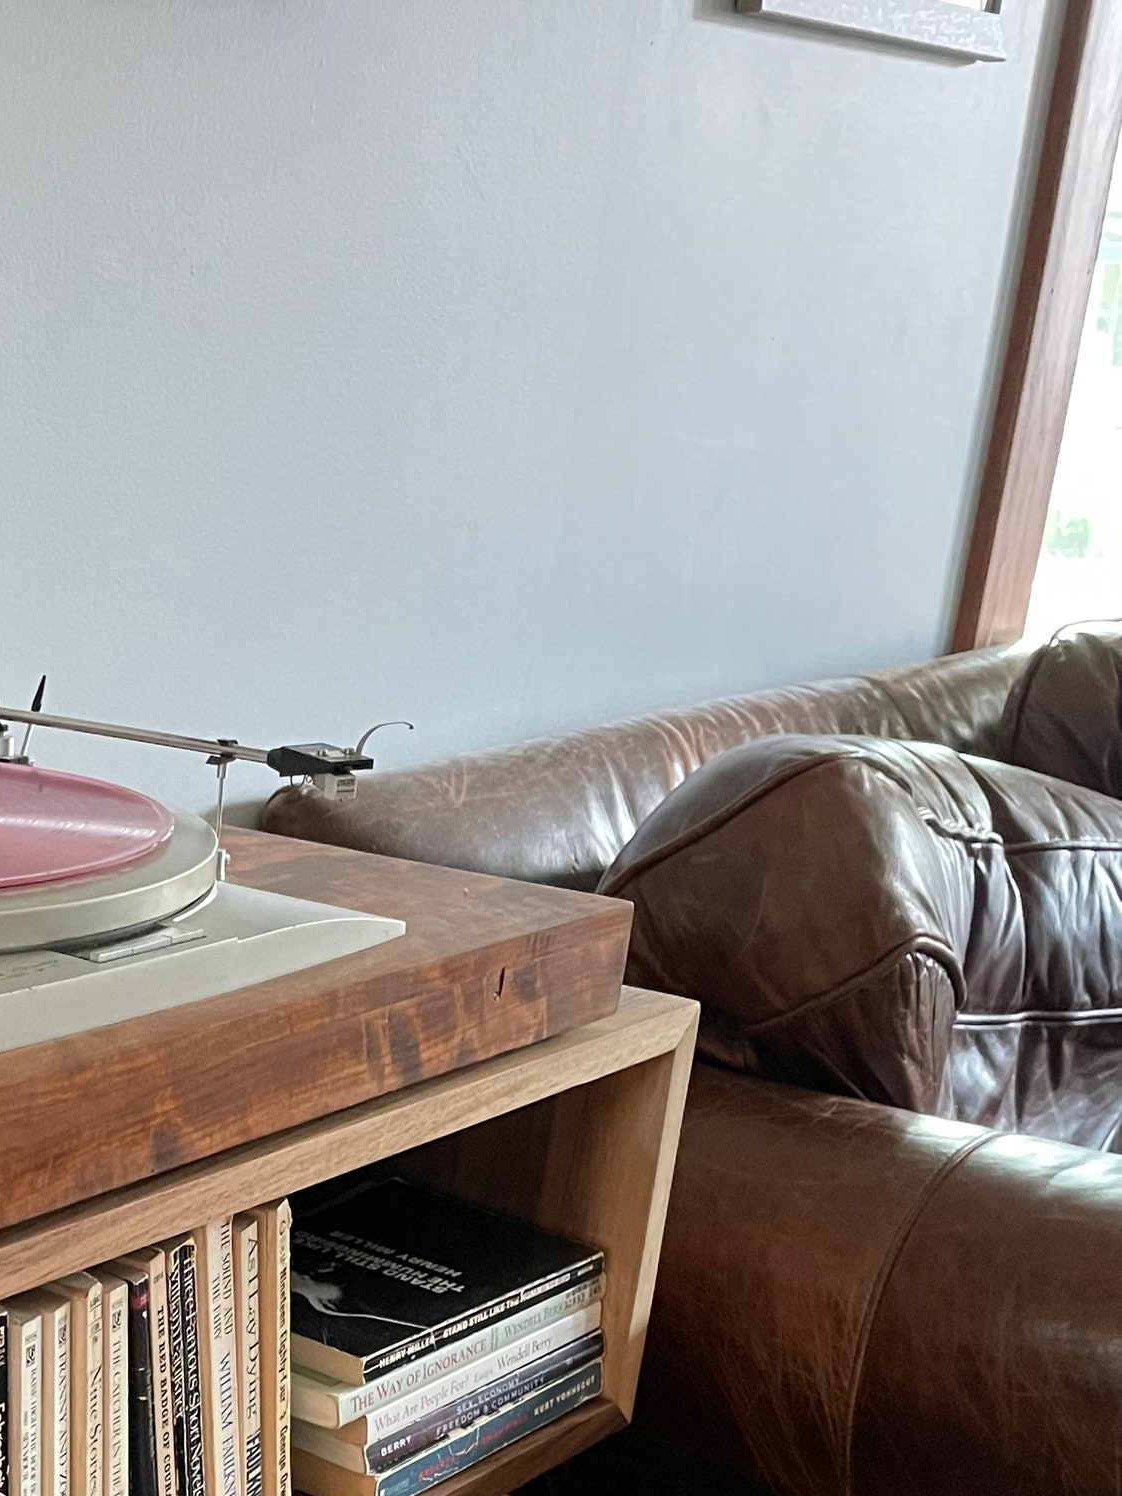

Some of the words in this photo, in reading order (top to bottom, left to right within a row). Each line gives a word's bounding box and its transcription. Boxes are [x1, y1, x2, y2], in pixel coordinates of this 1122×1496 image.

[221, 1221, 231, 1249] THE
[248, 1238, 259, 1272] As
[395, 1253, 463, 1278] HENRY
[211, 1274, 221, 1305] THE
[222, 1252, 233, 1300] SOUND
[382, 1269, 448, 1294] STAND
[427, 1275, 465, 1293] THE
[157, 1305, 165, 1339] THE
[212, 1305, 222, 1340] FURY
[223, 1306, 234, 1336] AND
[246, 1289, 259, 1335] Lay
[112, 1337, 122, 1366] THE
[186, 1310, 199, 1391] Famous
[379, 1352, 407, 1369] HENRY
[442, 1320, 468, 1338] STAND
[468, 1310, 489, 1327] STILL
[489, 1303, 506, 1319] LIKE
[159, 1340, 168, 1374] RED
[58, 1350, 67, 1422] FRANNY
[89, 1363, 102, 1422] Nine
[219, 1351, 234, 1431] WILLIAM
[245, 1341, 260, 1420] Dying
[350, 1392, 375, 1416] THE
[376, 1378, 404, 1401] WAY
[406, 1371, 422, 1387] OF
[423, 1338, 487, 1380] IGNORANCE
[374, 1411, 401, 1432] What
[402, 1403, 418, 1419] Are
[420, 1387, 449, 1410] People
[450, 1375, 469, 1395] For?
[496, 1343, 530, 1370] Wendell
[531, 1335, 553, 1354] Berry
[112, 1369, 122, 1439] CATCHER
[160, 1378, 170, 1428] BADGE
[188, 1391, 203, 1443] Short
[436, 1407, 481, 1436] FREEDOM
[490, 1375, 545, 1410] COMMUNITY
[533, 1399, 554, 1416] KURT
[58, 1429, 67, 1466] AND
[112, 1440, 121, 1458] IN
[162, 1431, 171, 1449] OF
[278, 1424, 289, 1471] George
[380, 1434, 412, 1457] BERRY
[89, 1422, 102, 1496] Stories
[112, 1461, 121, 1486] THE
